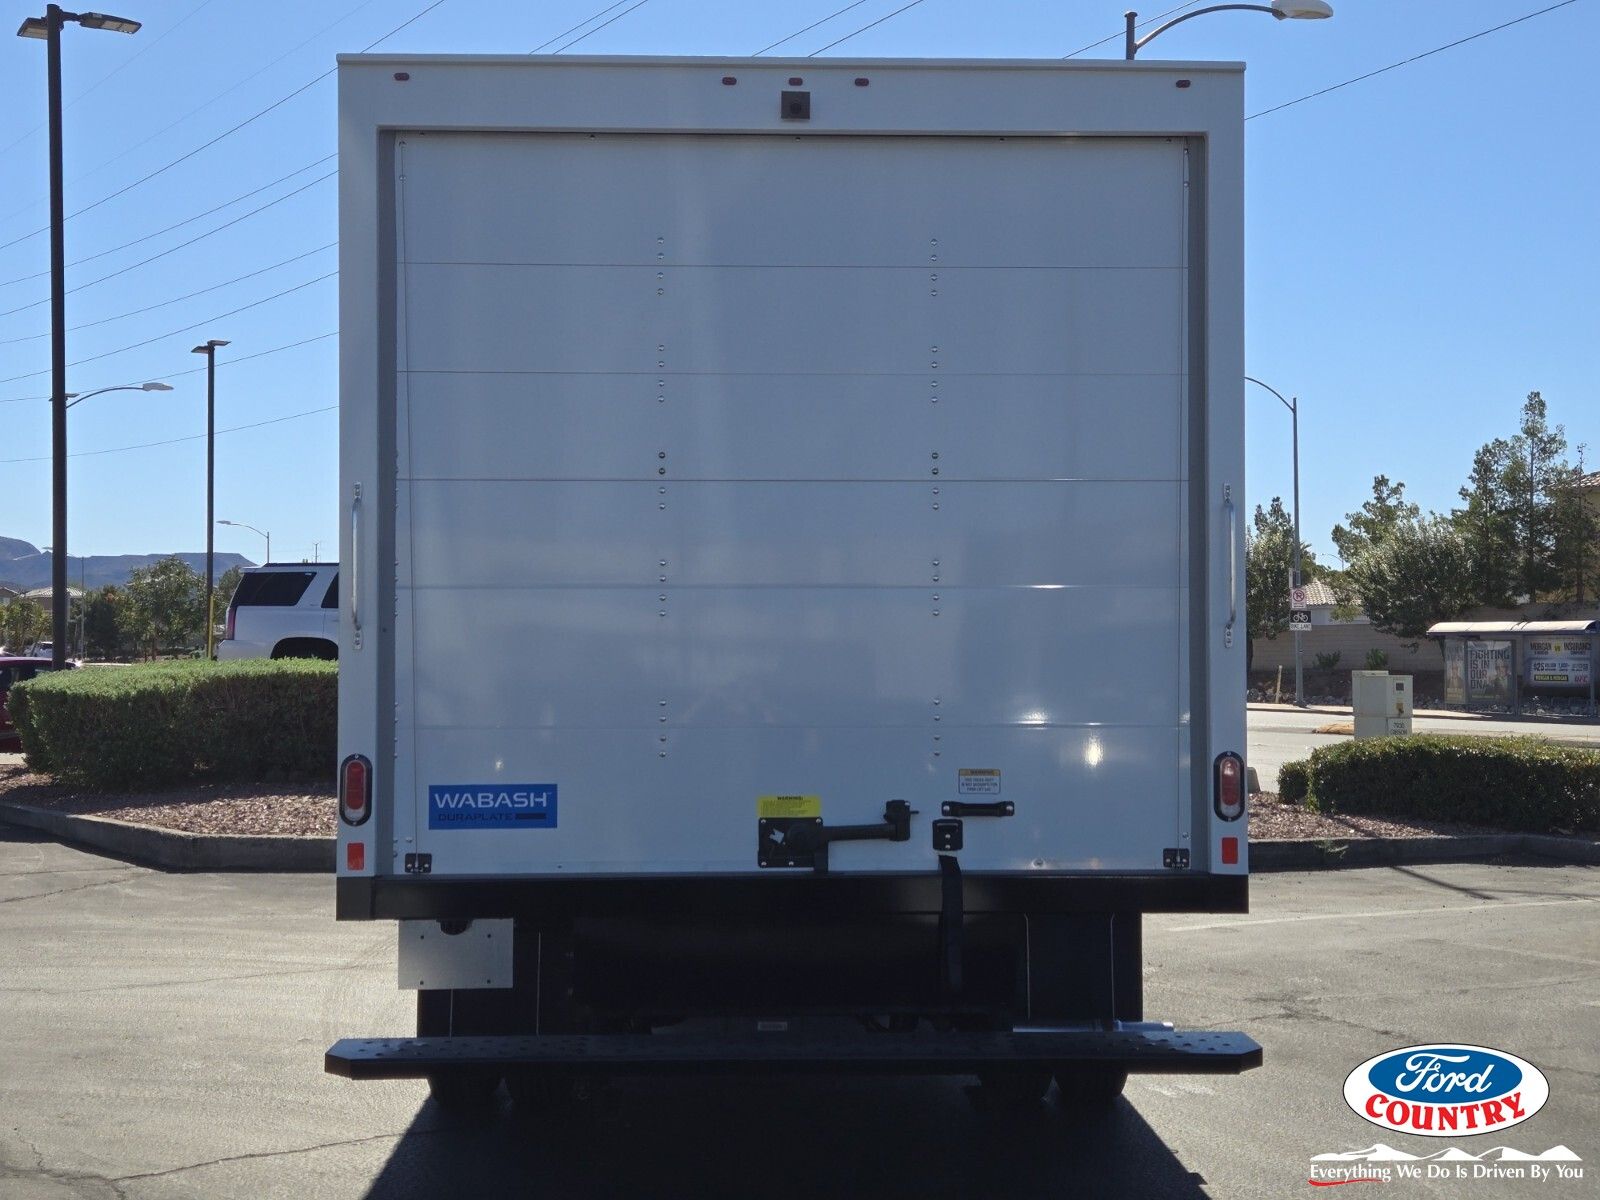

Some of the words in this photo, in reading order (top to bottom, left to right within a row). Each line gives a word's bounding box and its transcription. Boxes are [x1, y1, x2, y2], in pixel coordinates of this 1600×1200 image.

[1530, 642, 1551, 650] MORGAN
[1471, 650, 1510, 659] FIGHTING
[1471, 660, 1478, 669] IS
[1481, 660, 1489, 668] IN
[1471, 670, 1487, 679] OUR
[434, 792, 547, 808] WABASH
[438, 813, 513, 821] DURAPLATE
